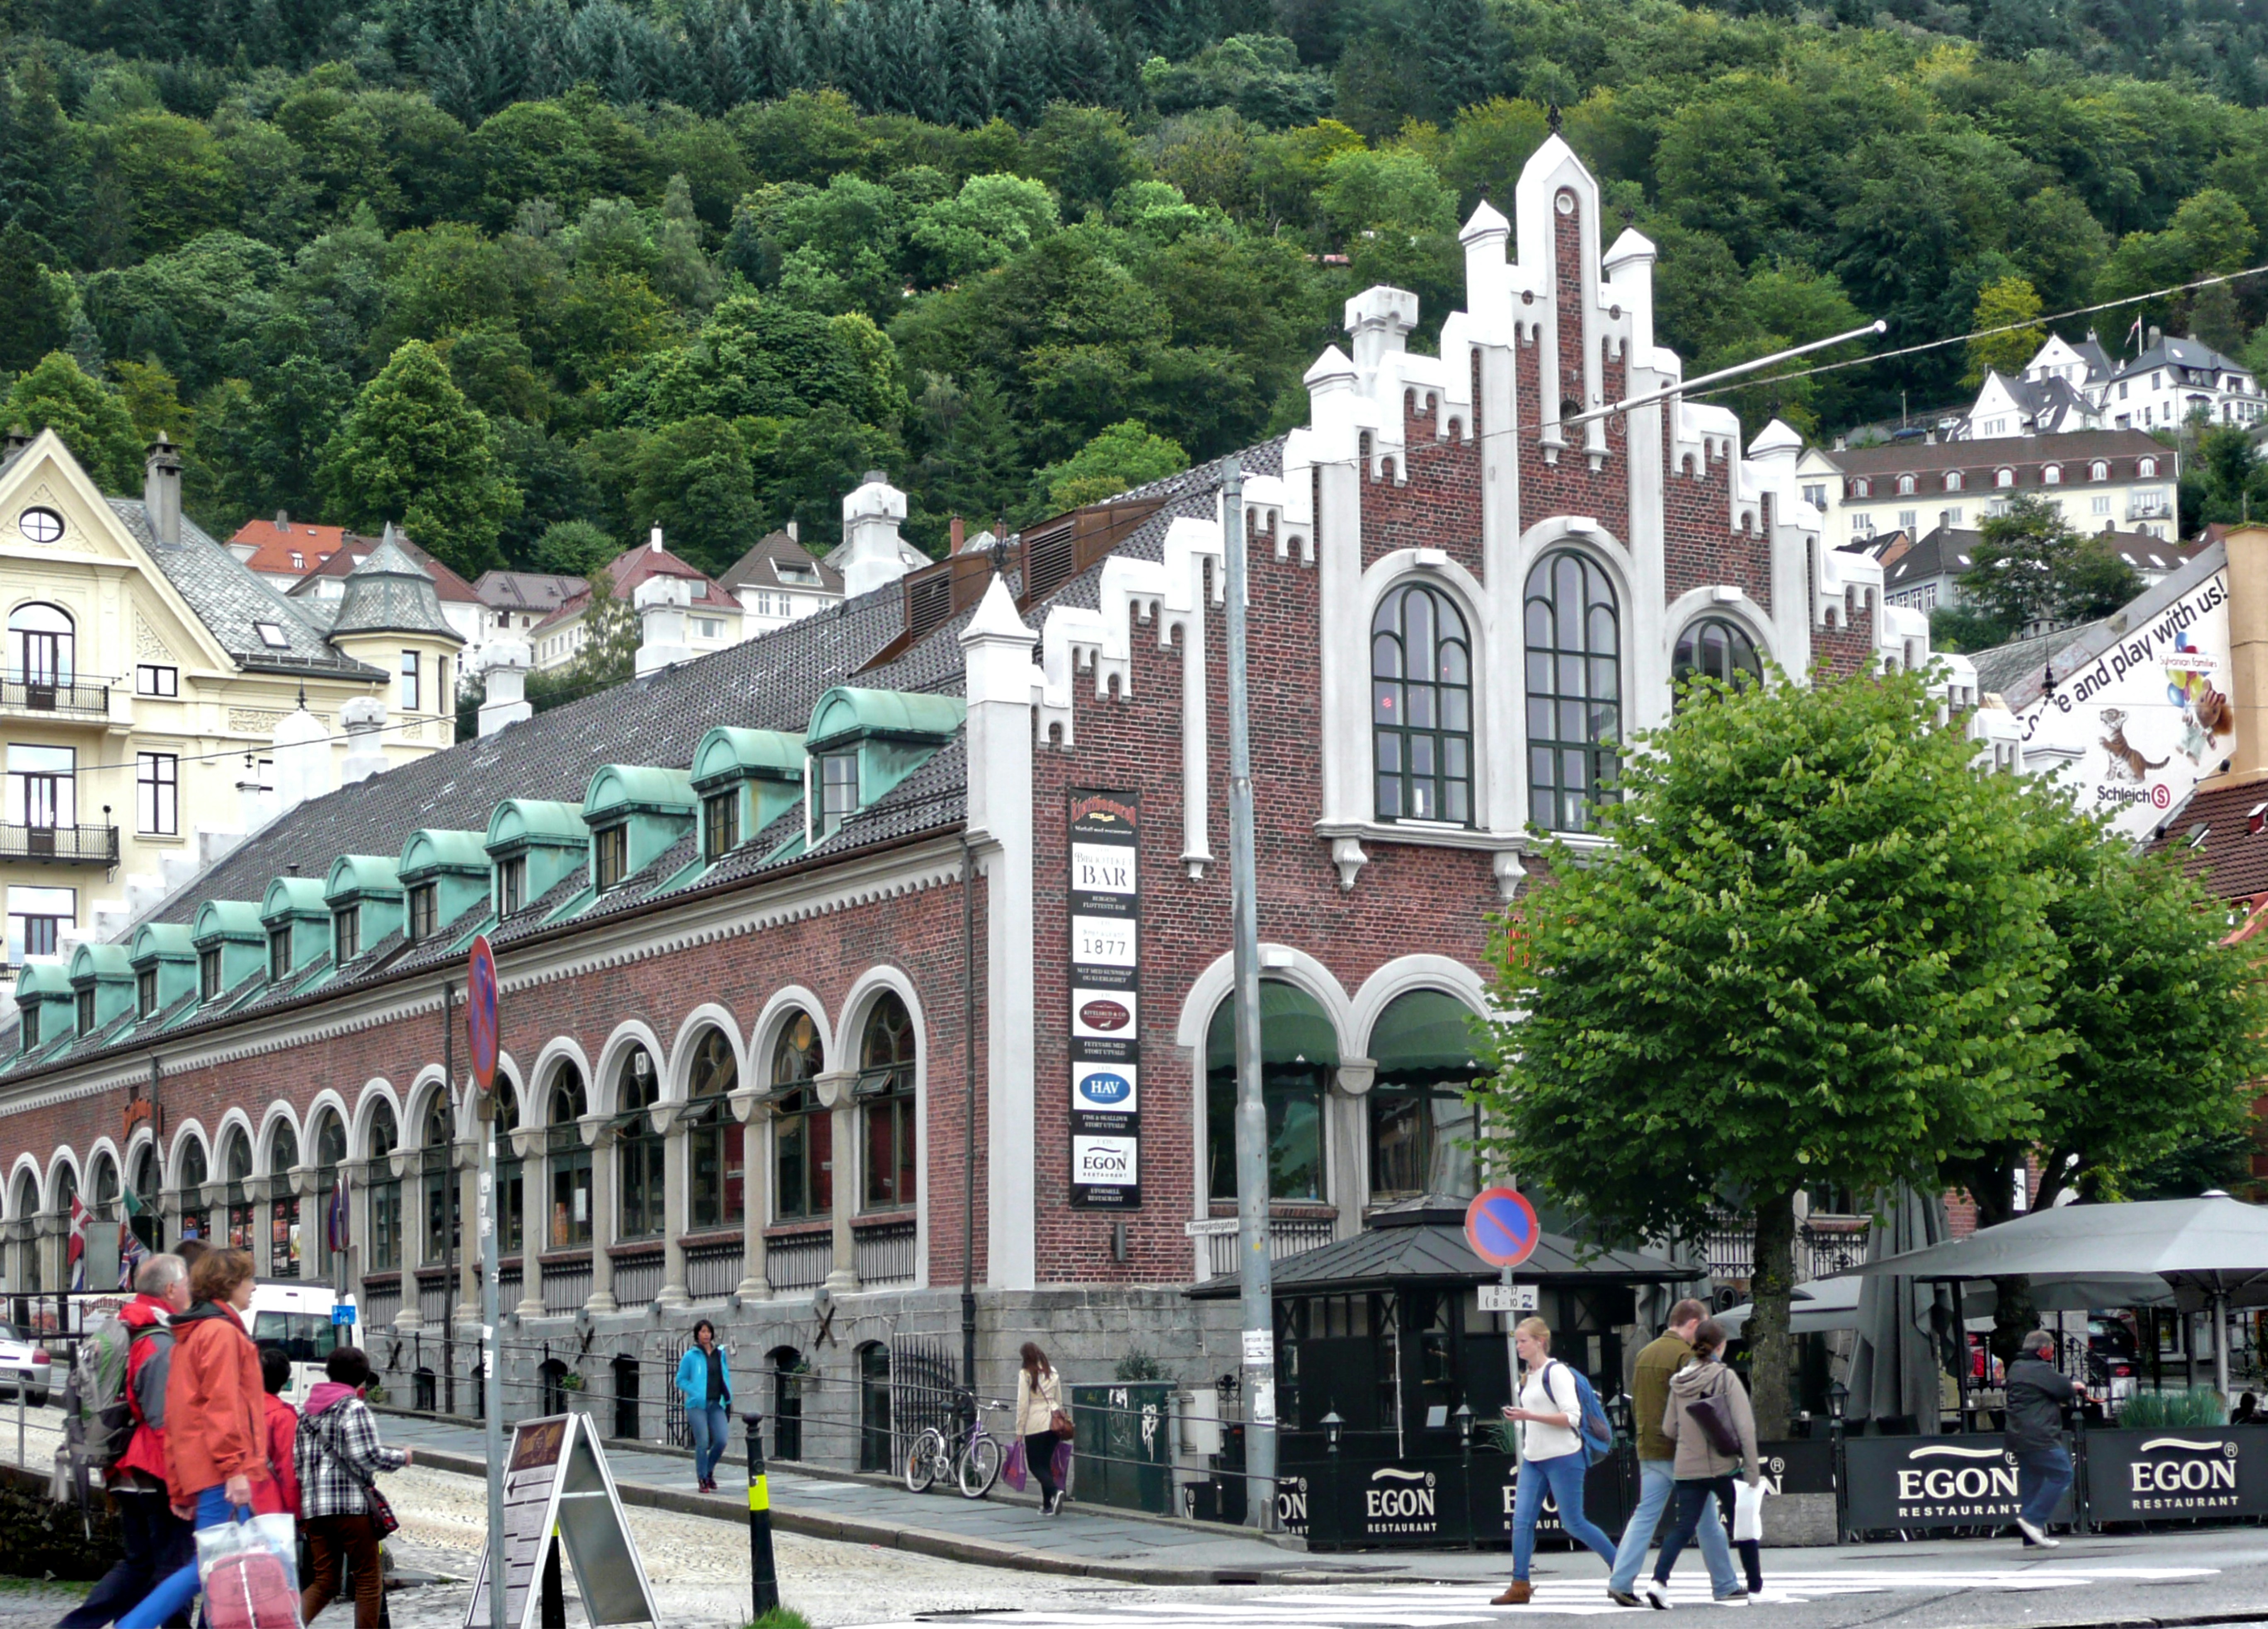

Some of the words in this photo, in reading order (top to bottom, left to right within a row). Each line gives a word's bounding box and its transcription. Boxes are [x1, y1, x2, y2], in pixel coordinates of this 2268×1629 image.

[2073, 658, 2111, 702] and
[2111, 634, 2153, 682] play
[2152, 601, 2197, 644] with
[2197, 575, 2228, 613] us!
[2097, 785, 2150, 803] Schleich
[1083, 865, 1127, 887] BAR
[1083, 938, 1126, 955] 1877
[1091, 1081, 1120, 1094] HAV
[1083, 1156, 1127, 1170] EGON
[1897, 1467, 2019, 1499] EGON
[2130, 1459, 2236, 1491] EGON
[1366, 1489, 1434, 1517] EGON
[1899, 1504, 2022, 1517] RESTAURANT
[2132, 1496, 2238, 1509] RESTAURANT
[1368, 1522, 1437, 1533] RESTAURANT
